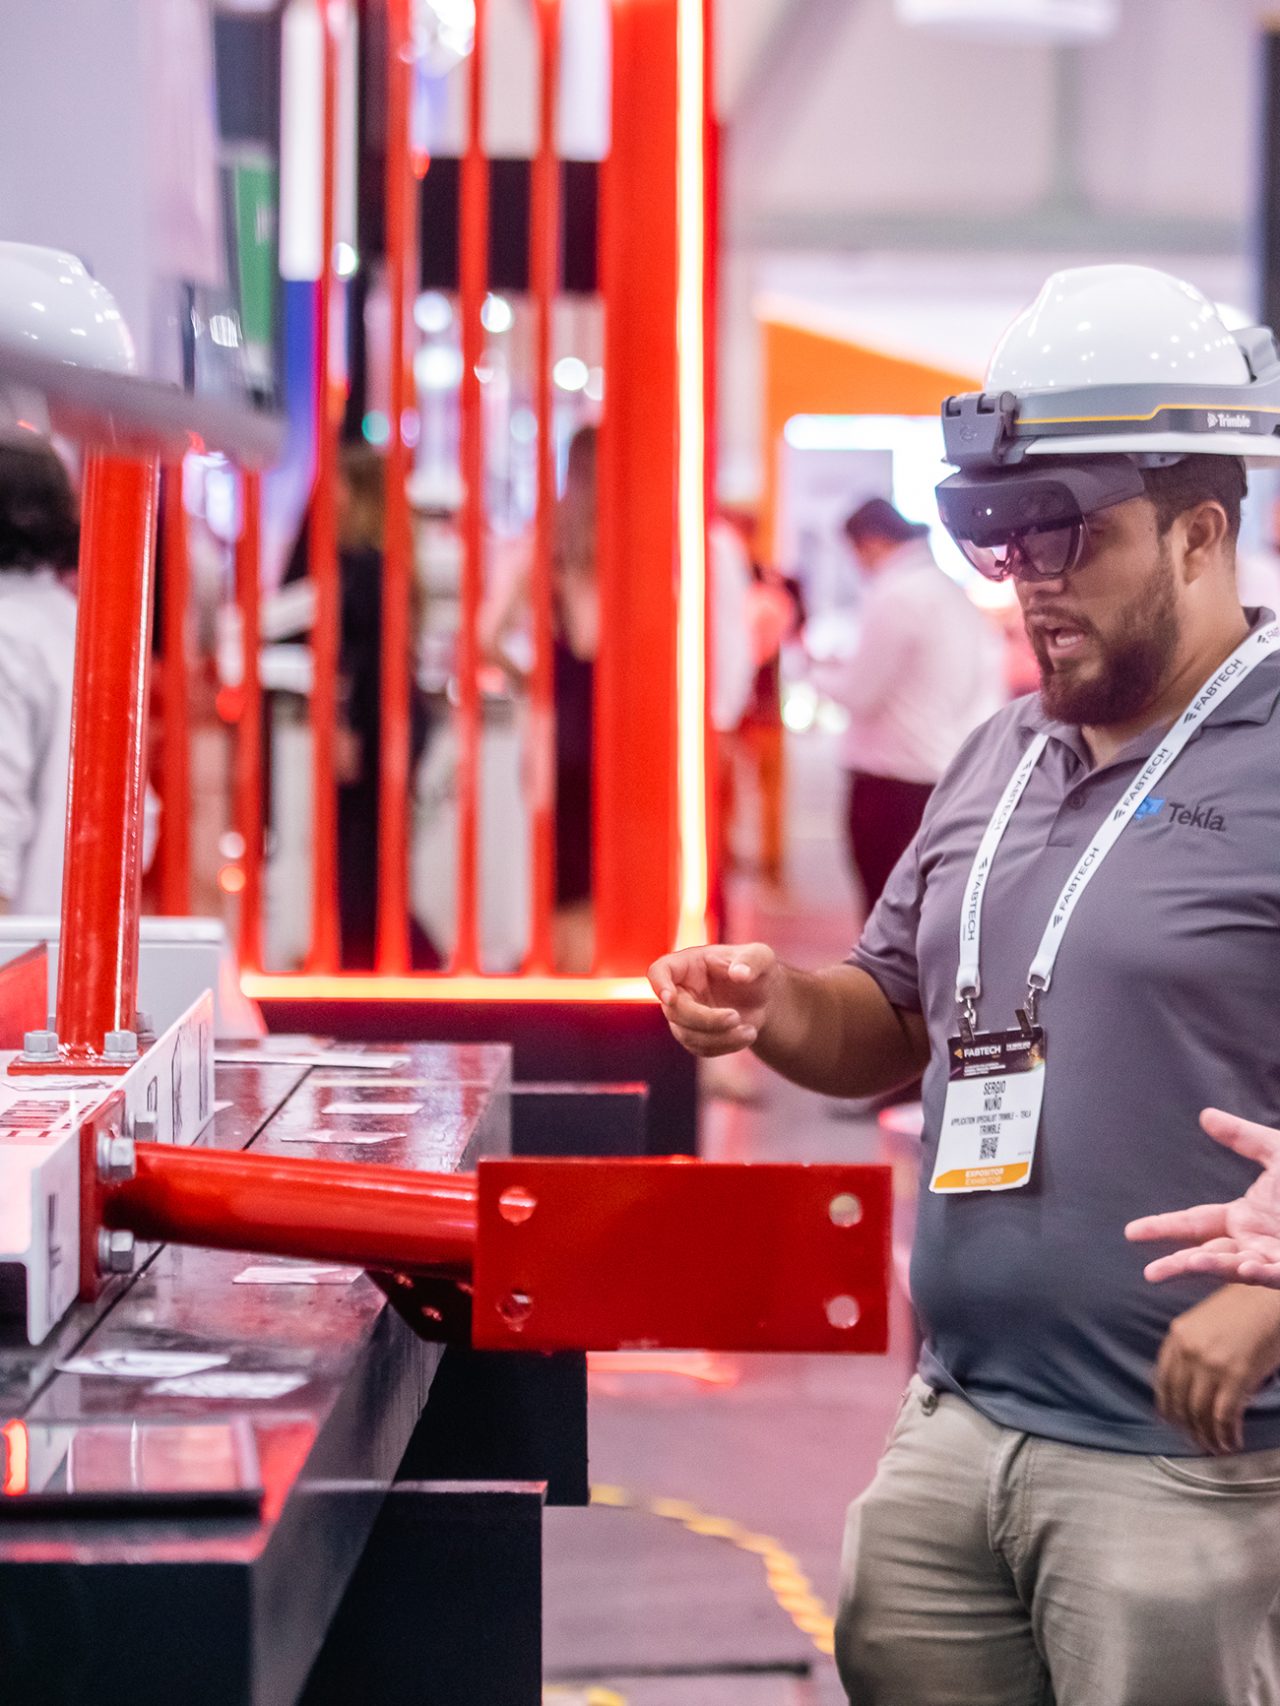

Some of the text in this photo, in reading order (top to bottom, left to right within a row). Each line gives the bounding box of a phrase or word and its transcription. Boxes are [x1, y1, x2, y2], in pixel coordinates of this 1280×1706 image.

[1217, 412, 1251, 428] Trimble
[1194, 658, 1242, 713] FABTECH
[1123, 748, 1168, 806] FABTECH
[967, 873, 984, 941] FABTECH
[1059, 847, 1100, 911] FABTECH
[964, 1045, 1001, 1057] FABTECH
